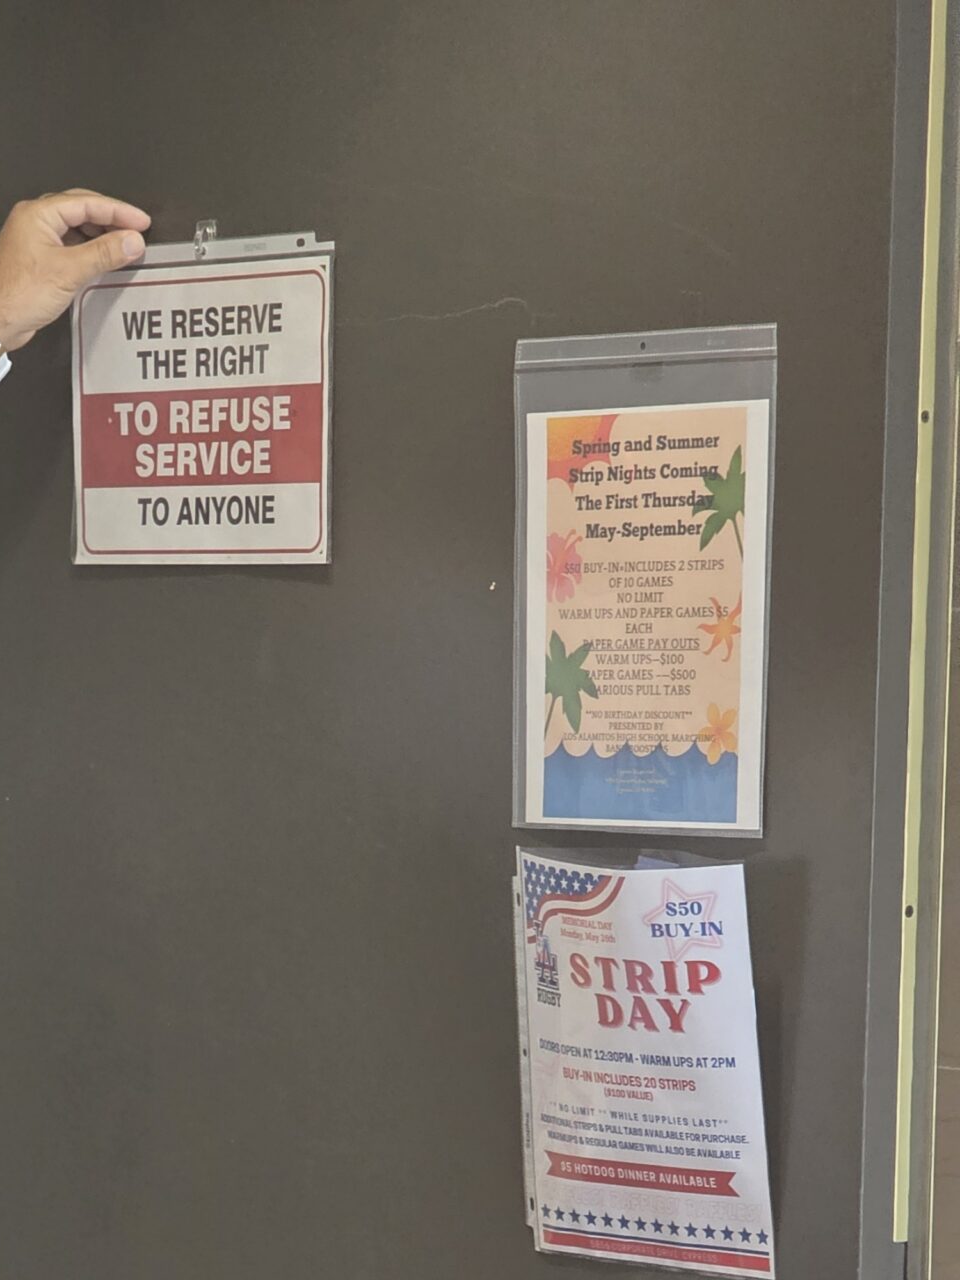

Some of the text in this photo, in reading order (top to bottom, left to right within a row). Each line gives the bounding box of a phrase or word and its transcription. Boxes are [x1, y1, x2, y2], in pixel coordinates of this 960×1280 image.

[122, 302, 283, 340] WE RESERVE
[137, 344, 269, 379] THE RIGHT
[114, 396, 291, 436] TO REFUSE
[572, 434, 719, 458] Spring and Summer
[135, 440, 271, 477] SERVICE
[569, 462, 718, 486] Strip Nights Coming
[576, 490, 715, 511] The First Thursday
[138, 495, 275, 526] TO ANYONE
[586, 520, 702, 541] May-September
[678, 561, 684, 571] 2
[687, 559, 724, 571] STRIPS
[609, 576, 673, 588] OF 10 GAMES
[617, 592, 663, 603] NO LIMIT
[559, 606, 728, 619] WARM UPS AND PAPER GAMES $5
[625, 623, 652, 633] EACH
[617, 638, 645, 649] GAME
[648, 638, 668, 649] PAY
[671, 638, 700, 649] OUTS
[596, 654, 629, 665] WARM
[617, 670, 653, 680] GAMES
[595, 685, 691, 695] ARIOUS PULL TABS
[604, 711, 643, 719] BIRTHDAY
[608, 722, 664, 730] PRESENTED BY
[639, 733, 670, 741] SCHOOL
[665, 901, 702, 916] $50
[597, 921, 613, 931] DAY
[650, 921, 723, 938] BUY-IN
[585, 931, 600, 943] May
[569, 952, 722, 995] STRIP
[537, 987, 561, 1007] RUGBY
[594, 993, 692, 1033] DAY
[561, 1044, 581, 1057] OPEN
[583, 1048, 592, 1059] AT
[594, 1049, 633, 1063] 12:30PM
[640, 1054, 672, 1066] WARM
[673, 1056, 693, 1068] UPS
[695, 1057, 710, 1068] AT
[711, 1057, 736, 1068] 2PM
[563, 1067, 696, 1091] BUY-IN INCLUDES 20 STRIPS
[627, 1091, 654, 1102] VALUE)
[559, 1104, 569, 1113] NO
[571, 1105, 595, 1117] LIMIT
[610, 1111, 639, 1122] WHILE
[642, 1114, 689, 1126] SUPPLIES
[605, 1125, 623, 1135] PULL
[645, 1129, 685, 1140] AVAILABLE
[686, 1132, 701, 1142] FOR
[646, 1144, 665, 1154] WILL
[686, 1148, 697, 1157] BE
[697, 1148, 740, 1159] AVAILABLE
[560, 1161, 717, 1188] $5 HOTDOG DINNER AVAILABLE
